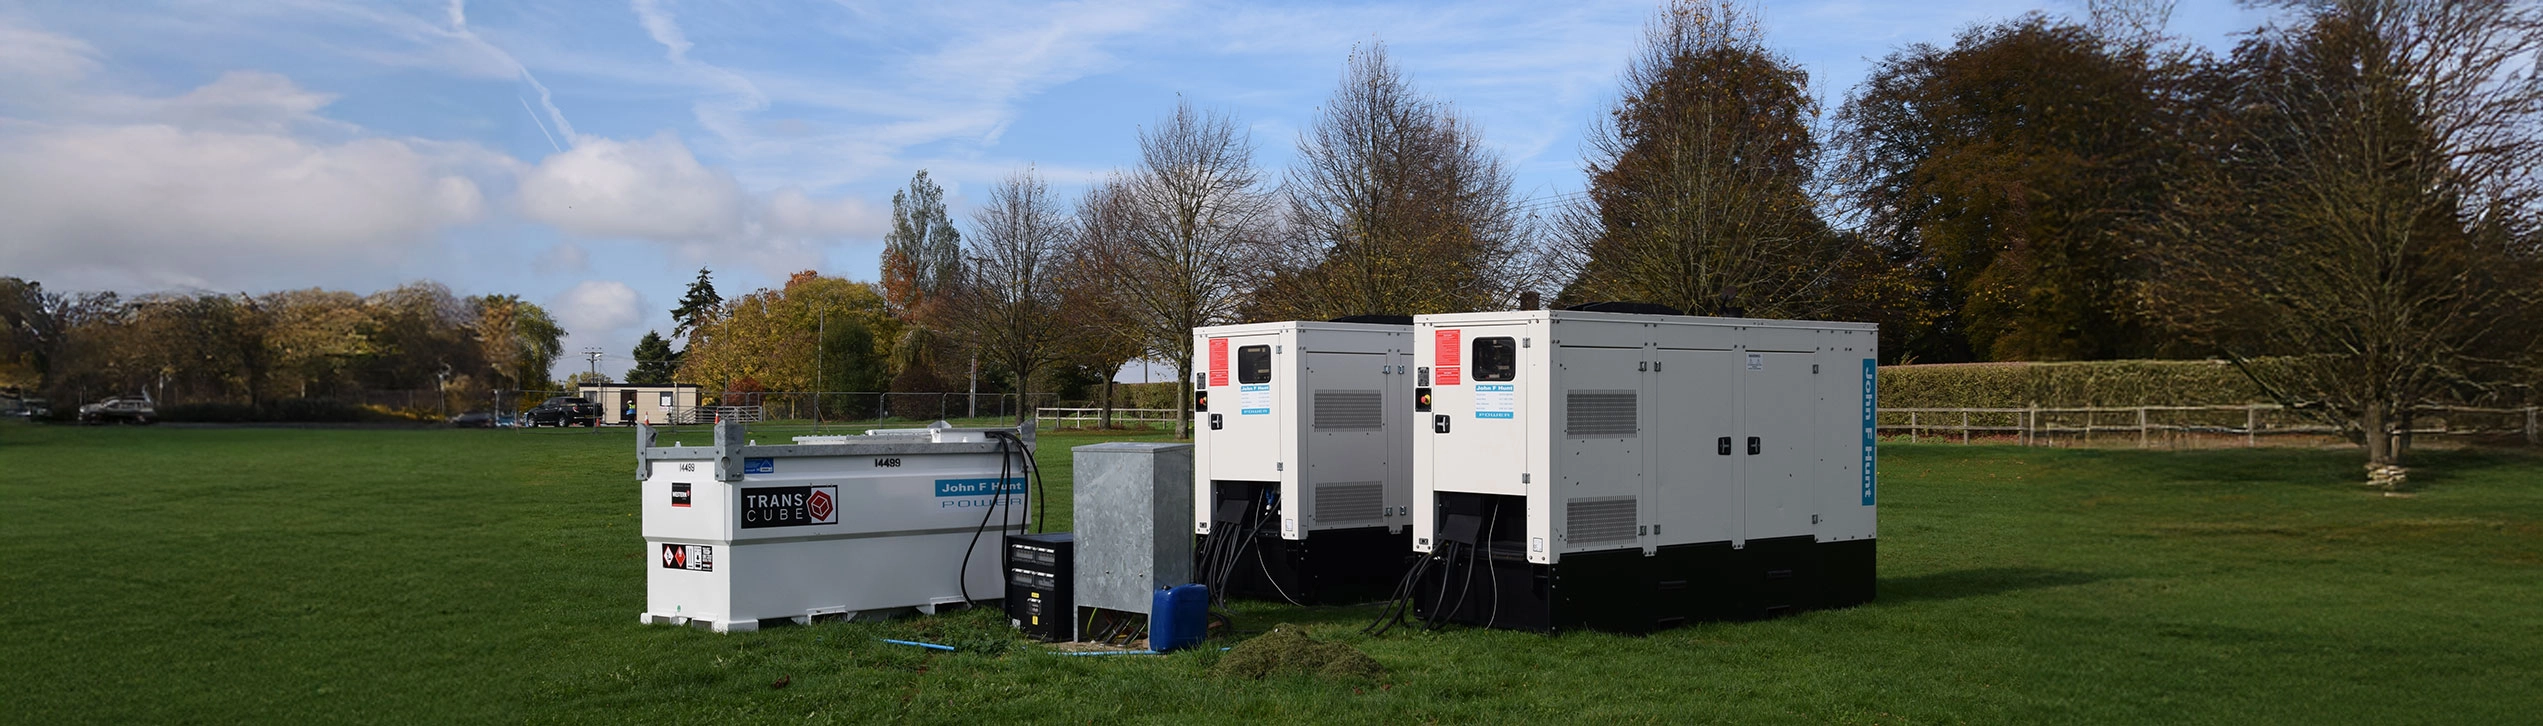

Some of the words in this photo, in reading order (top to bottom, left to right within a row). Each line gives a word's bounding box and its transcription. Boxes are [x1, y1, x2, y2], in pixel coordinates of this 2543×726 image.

[1865, 427, 1873, 440] F
[875, 458, 901, 468] 14499
[1865, 446, 1873, 498] Hunt
[942, 483, 975, 493] John
[979, 482, 987, 491] F
[991, 481, 1022, 491] Hunt
[746, 493, 803, 508] TRANS
[942, 498, 1022, 508] POWER
[746, 508, 803, 522] CUBE
